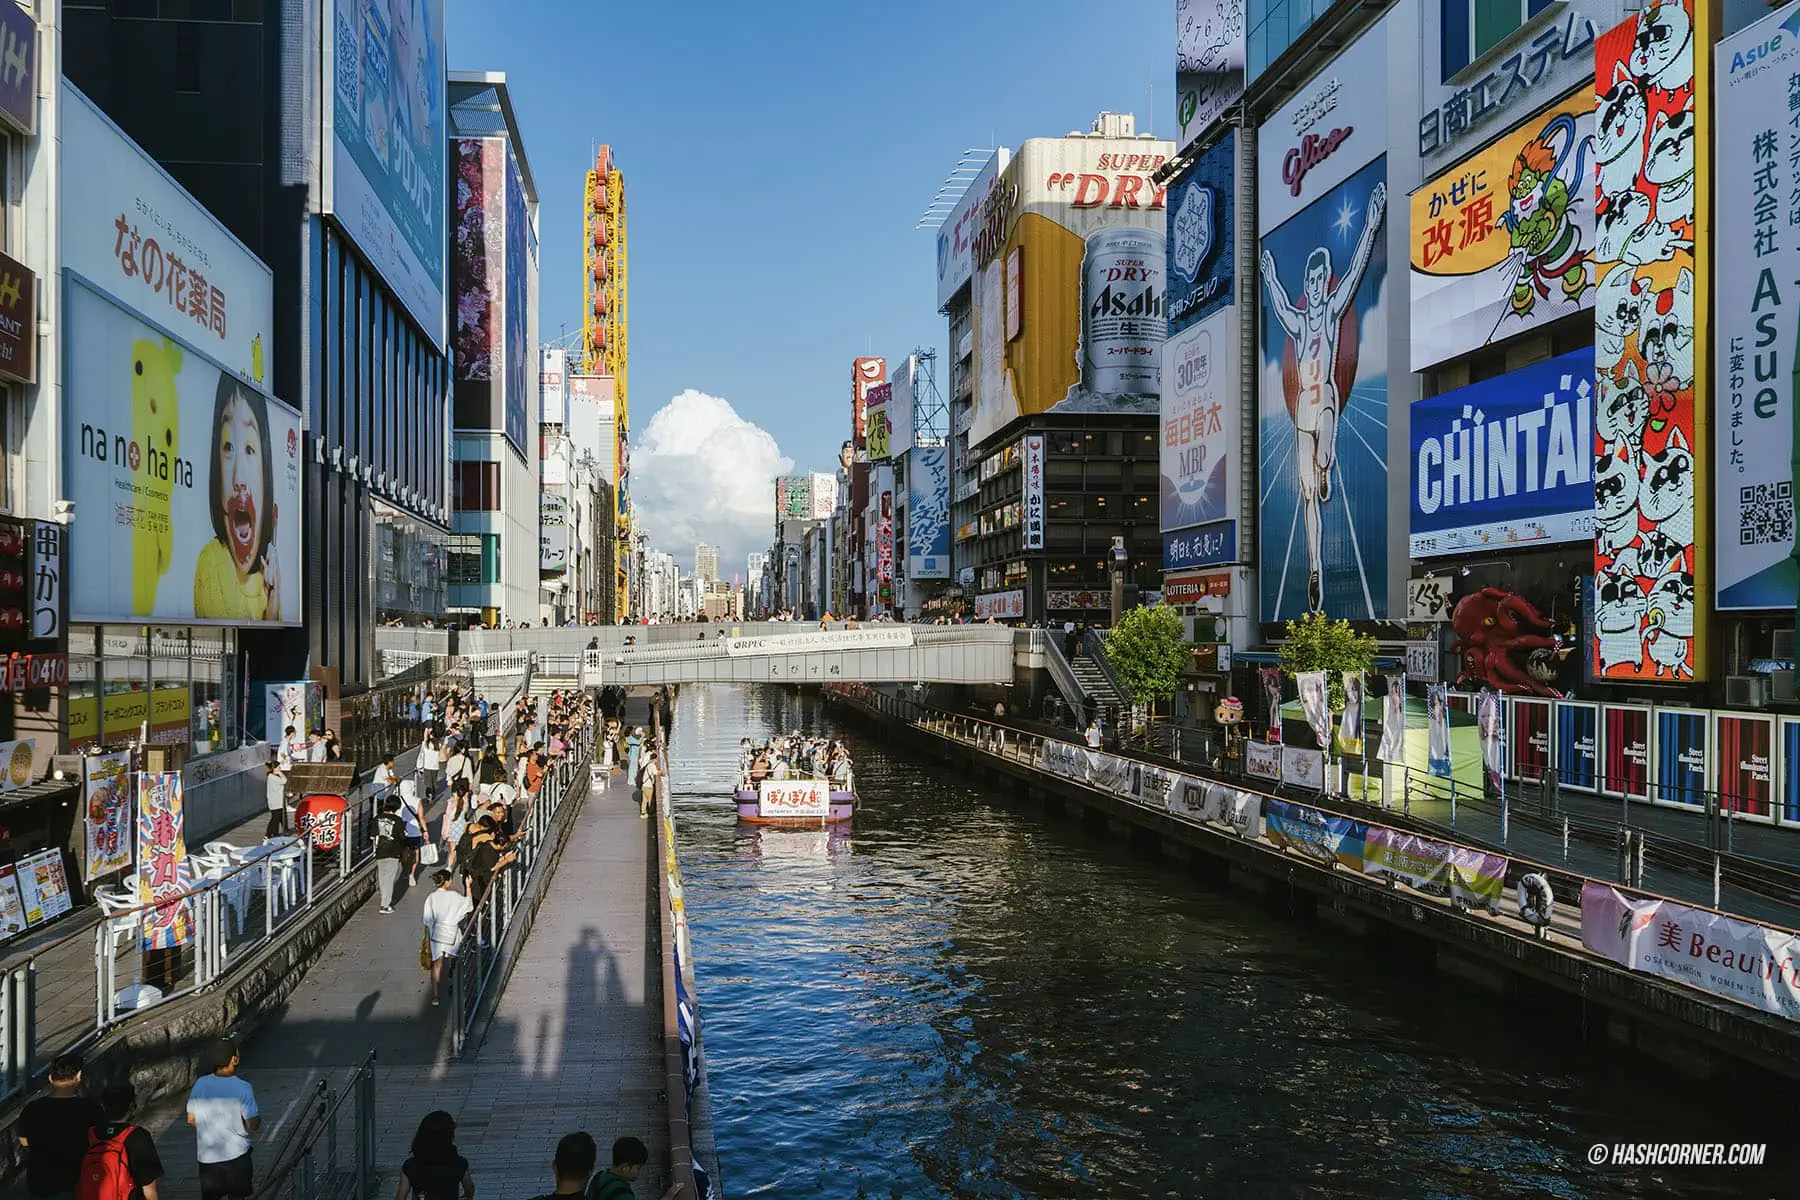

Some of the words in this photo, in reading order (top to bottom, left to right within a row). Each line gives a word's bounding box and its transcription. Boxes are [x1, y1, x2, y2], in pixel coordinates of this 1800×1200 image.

[1729, 33, 1783, 74] Asue
[1419, 11, 1595, 158] 日商エステム
[1097, 153, 1166, 171] SUPER
[1282, 126, 1354, 198] Glico
[1428, 169, 1488, 219] かぜに
[1752, 128, 1780, 259] 株式会社
[1422, 191, 1495, 269] 改源
[114, 212, 226, 341] なの花薬局
[1115, 258, 1145, 268] SUPER
[1120, 321, 1140, 336] 生
[1751, 266, 1782, 421] Asue
[1165, 401, 1223, 448] 毎日骨太
[1729, 336, 1746, 477] に変わりました。
[876, 410, 886, 456] 高収入
[1418, 373, 1593, 515] CHINTAI
[1179, 444, 1207, 478] MBP
[36, 525, 58, 636] 串かつ
[1167, 582, 1199, 597] LOTTERIA
[1415, 583, 1444, 616] くくる
[30, 659, 66, 684] 0410
[1657, 920, 1684, 953] 美
